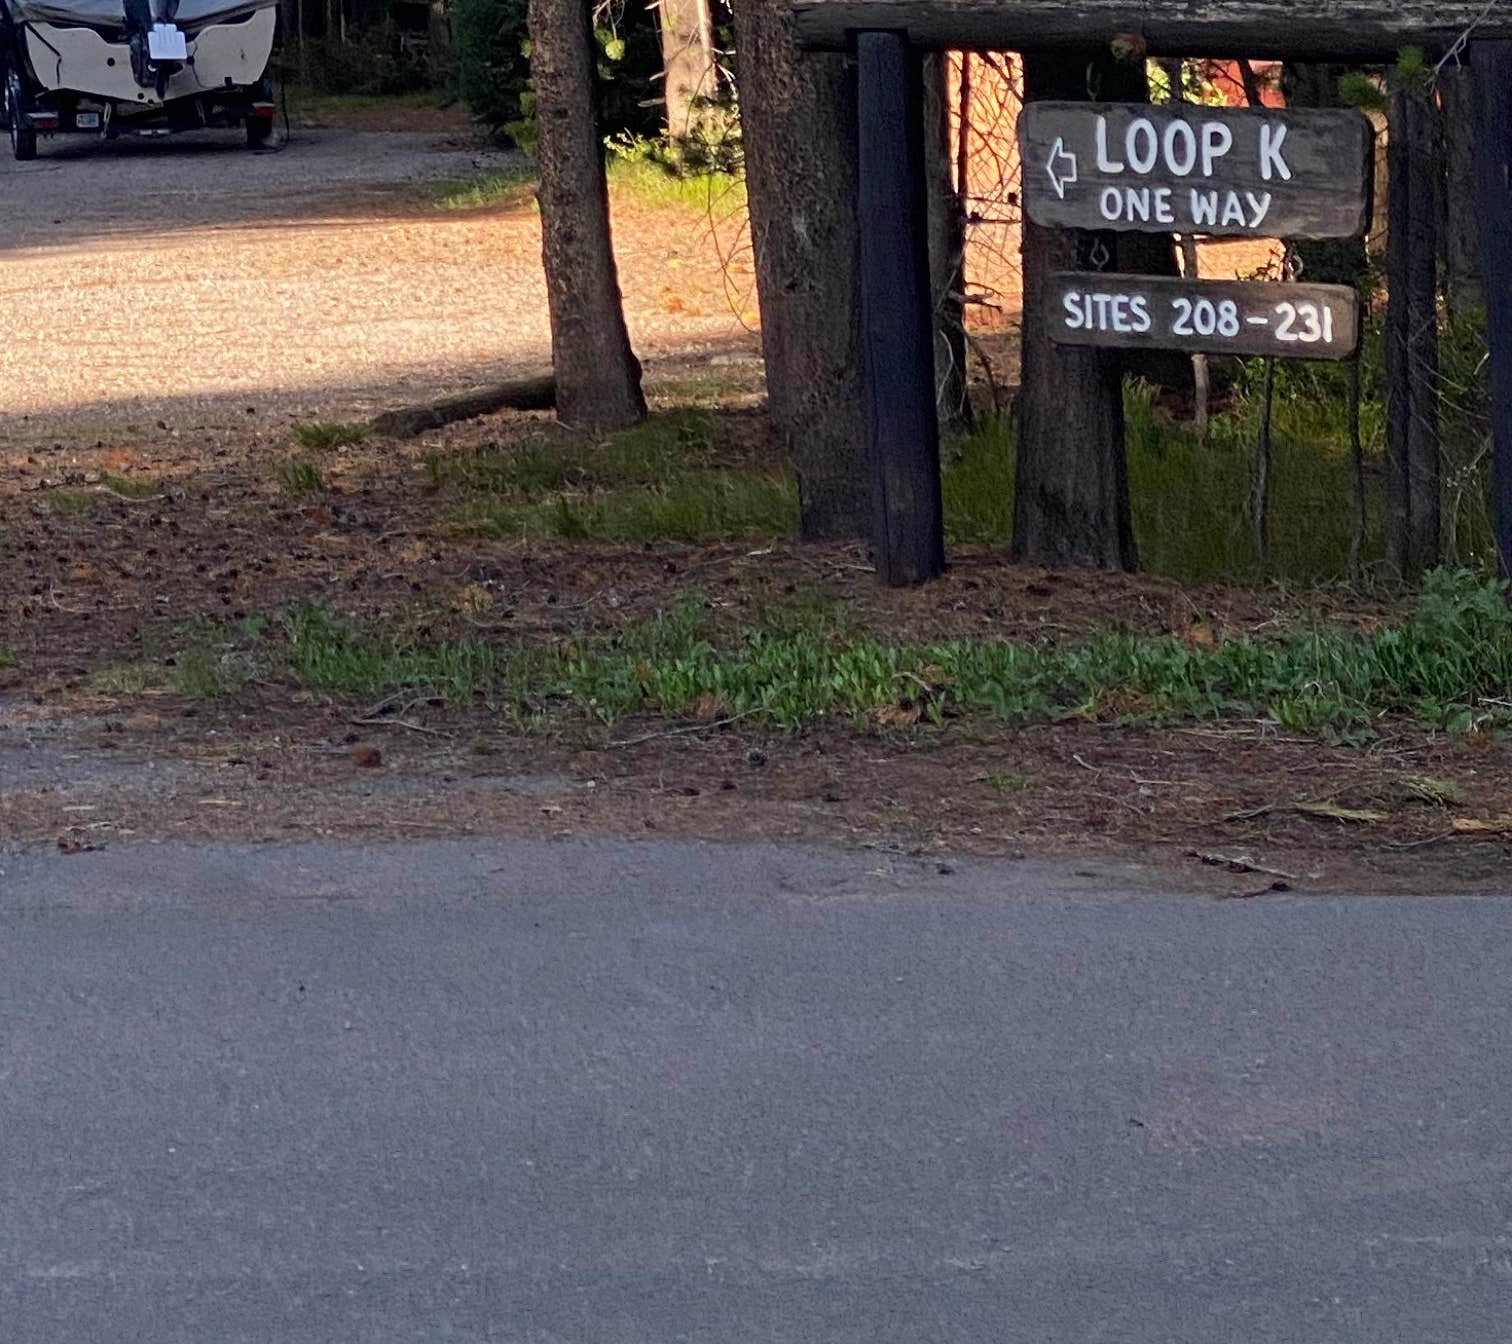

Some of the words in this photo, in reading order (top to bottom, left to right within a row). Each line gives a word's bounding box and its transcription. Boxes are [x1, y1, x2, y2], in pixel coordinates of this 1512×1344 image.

[1095, 115, 1233, 178] LOOP
[1259, 123, 1292, 181] K
[1099, 187, 1175, 224] ONE
[1190, 189, 1272, 229] WAY
[1062, 291, 1152, 333] SITES
